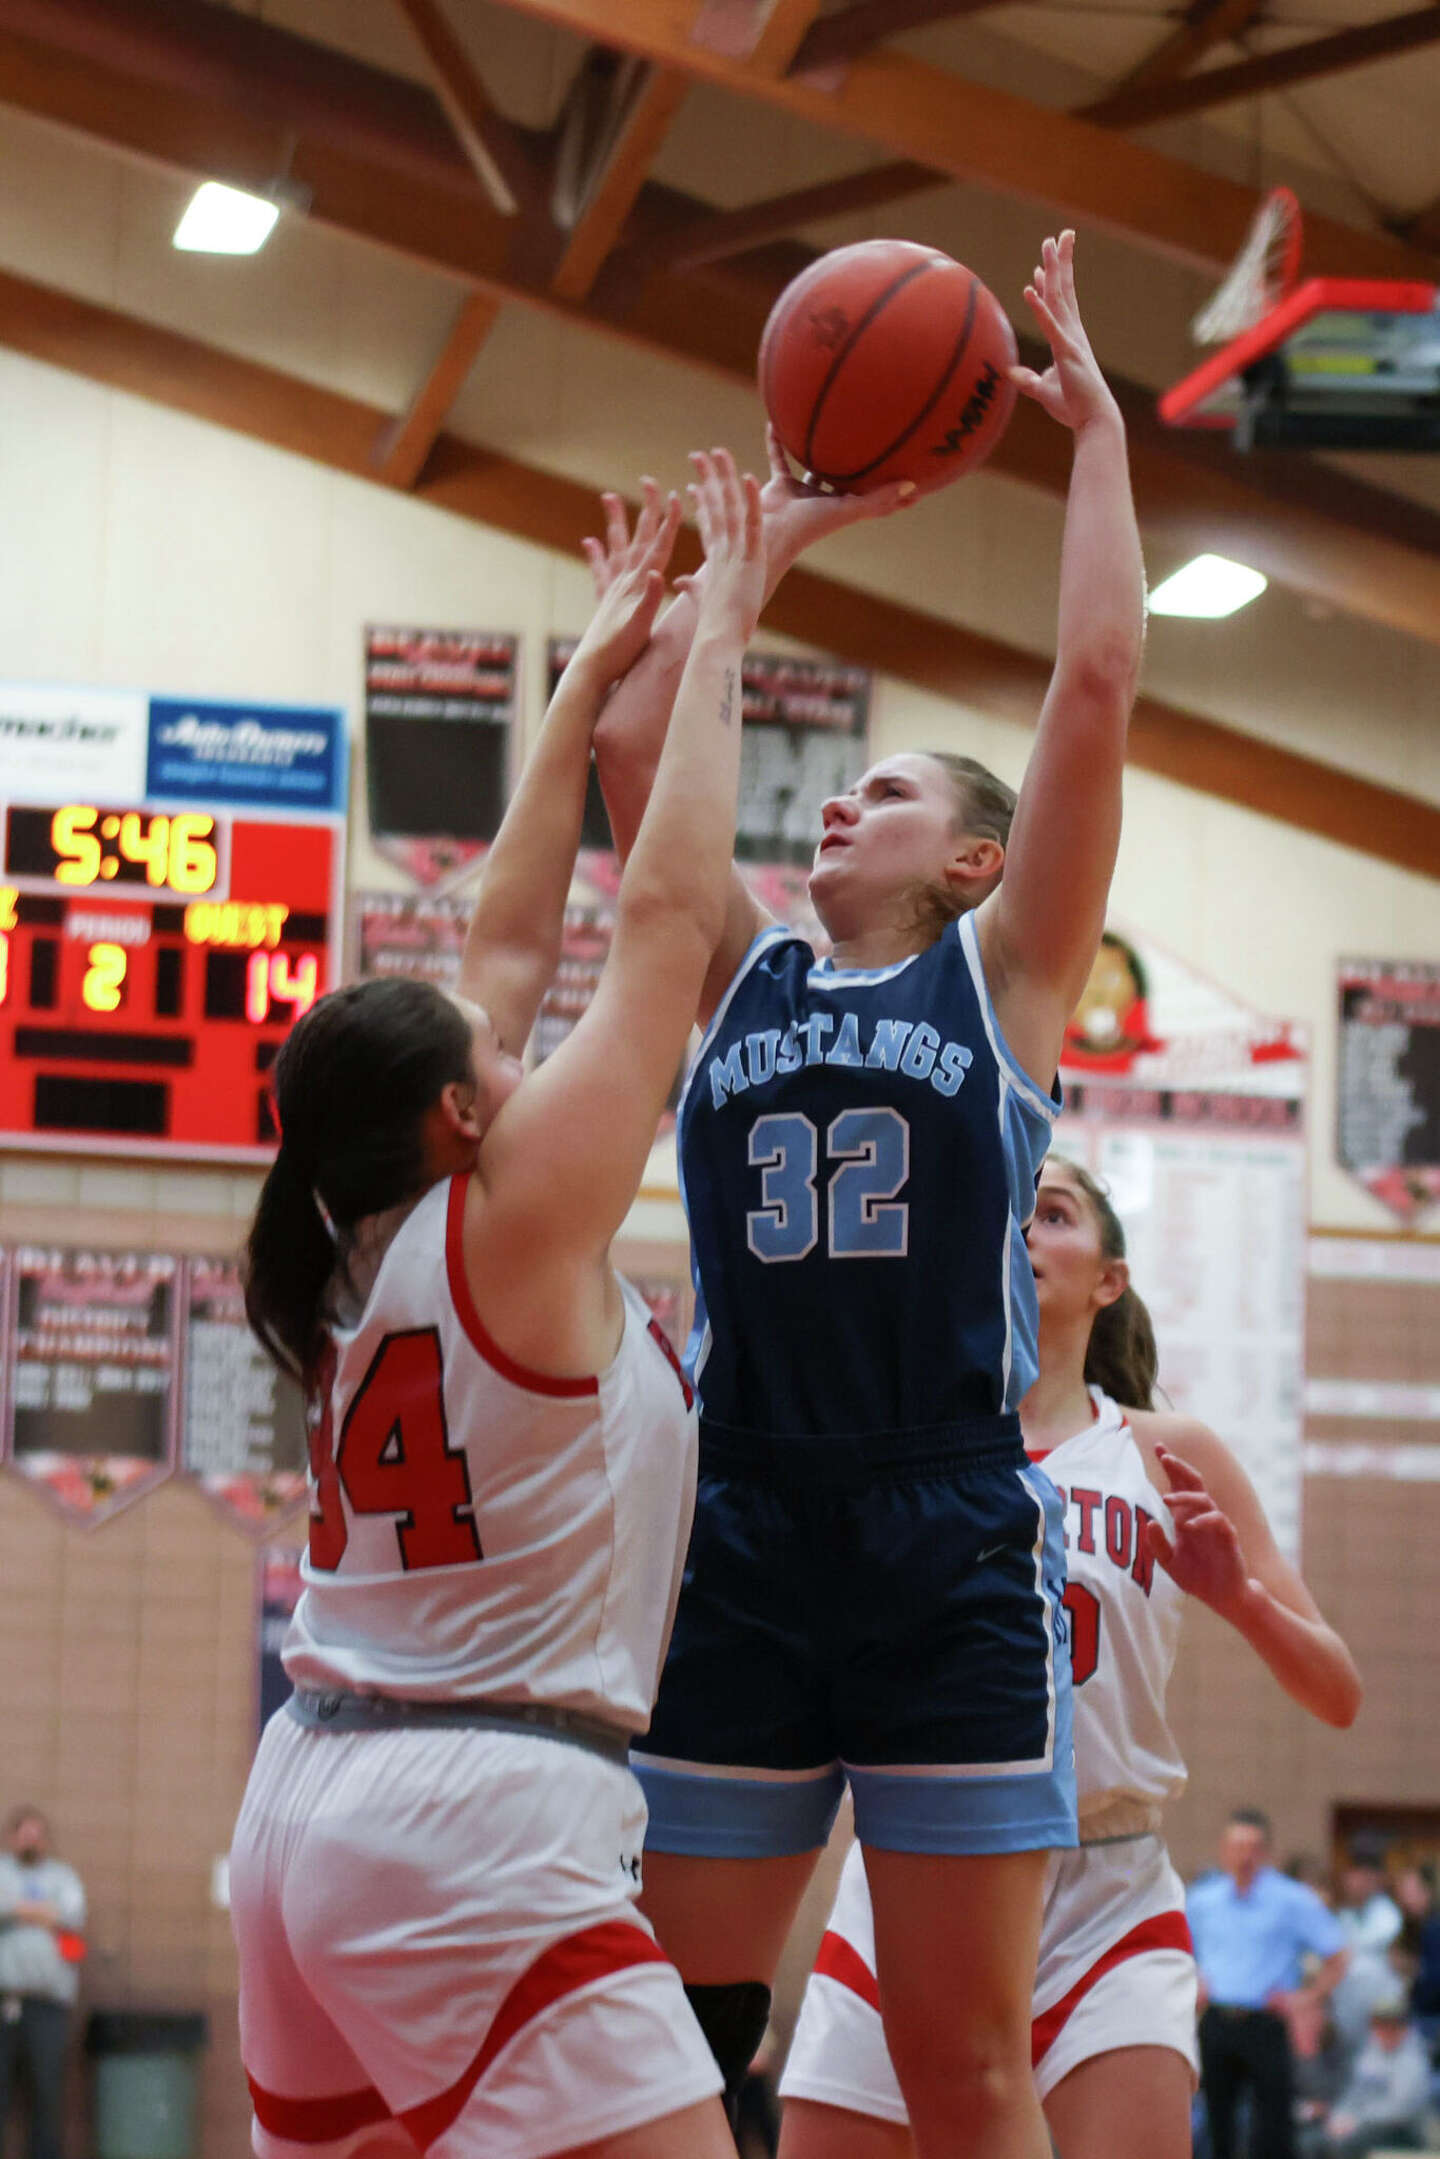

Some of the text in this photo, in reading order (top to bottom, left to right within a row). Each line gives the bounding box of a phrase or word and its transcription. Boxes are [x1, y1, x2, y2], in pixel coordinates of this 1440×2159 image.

[51, 804, 217, 894] 5:46
[83, 942, 127, 1012] 2
[246, 950, 318, 1024] 14
[709, 1012, 974, 1111] MUSTANGS
[746, 1106, 910, 1264] 32
